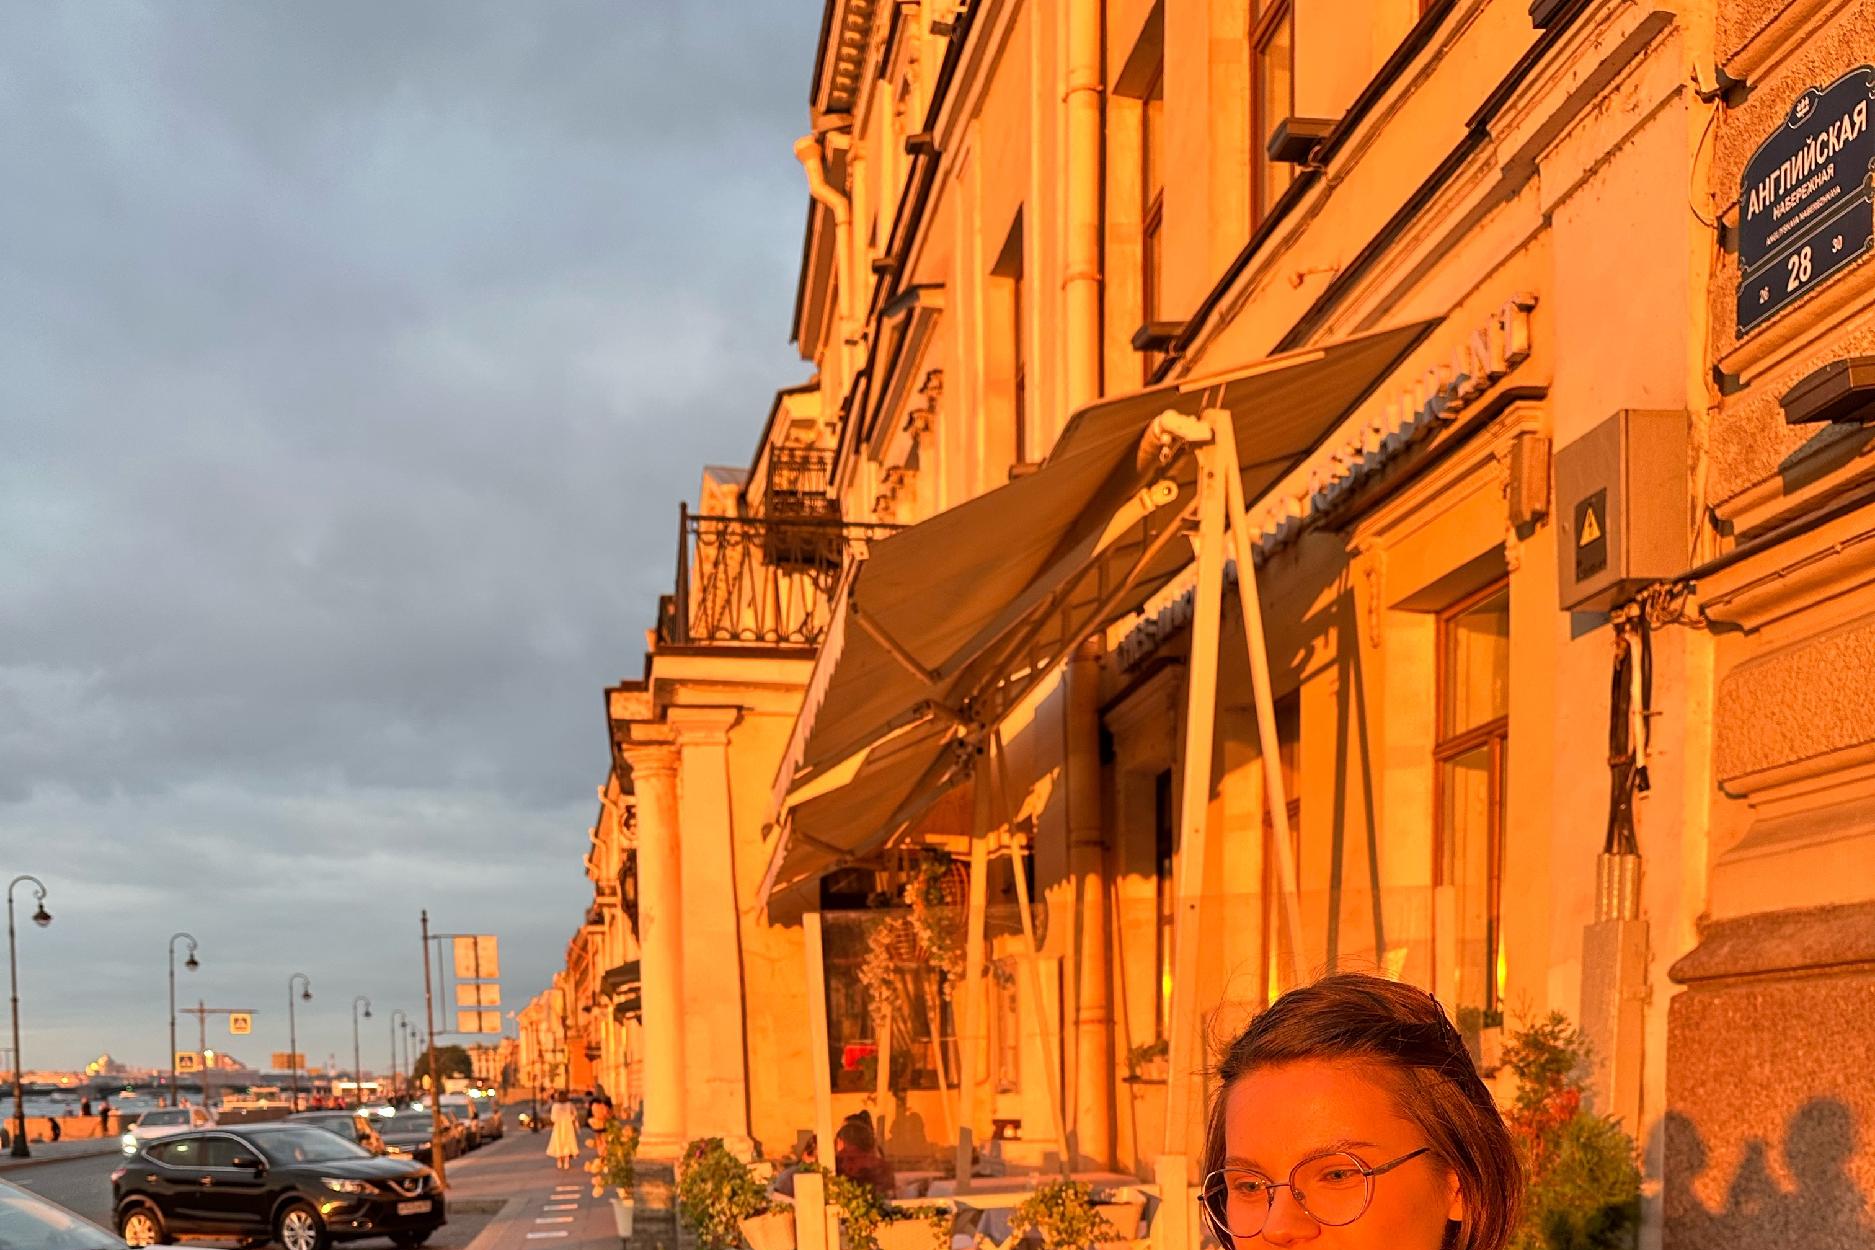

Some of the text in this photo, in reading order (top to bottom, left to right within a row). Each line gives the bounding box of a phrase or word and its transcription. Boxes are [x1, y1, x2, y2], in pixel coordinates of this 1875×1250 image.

[1747, 99, 1867, 221] АНГЛИЙСКАЯ
[1772, 163, 1835, 221] НАБЕРЕЖНАЯ
[1786, 245, 1812, 293] 28
